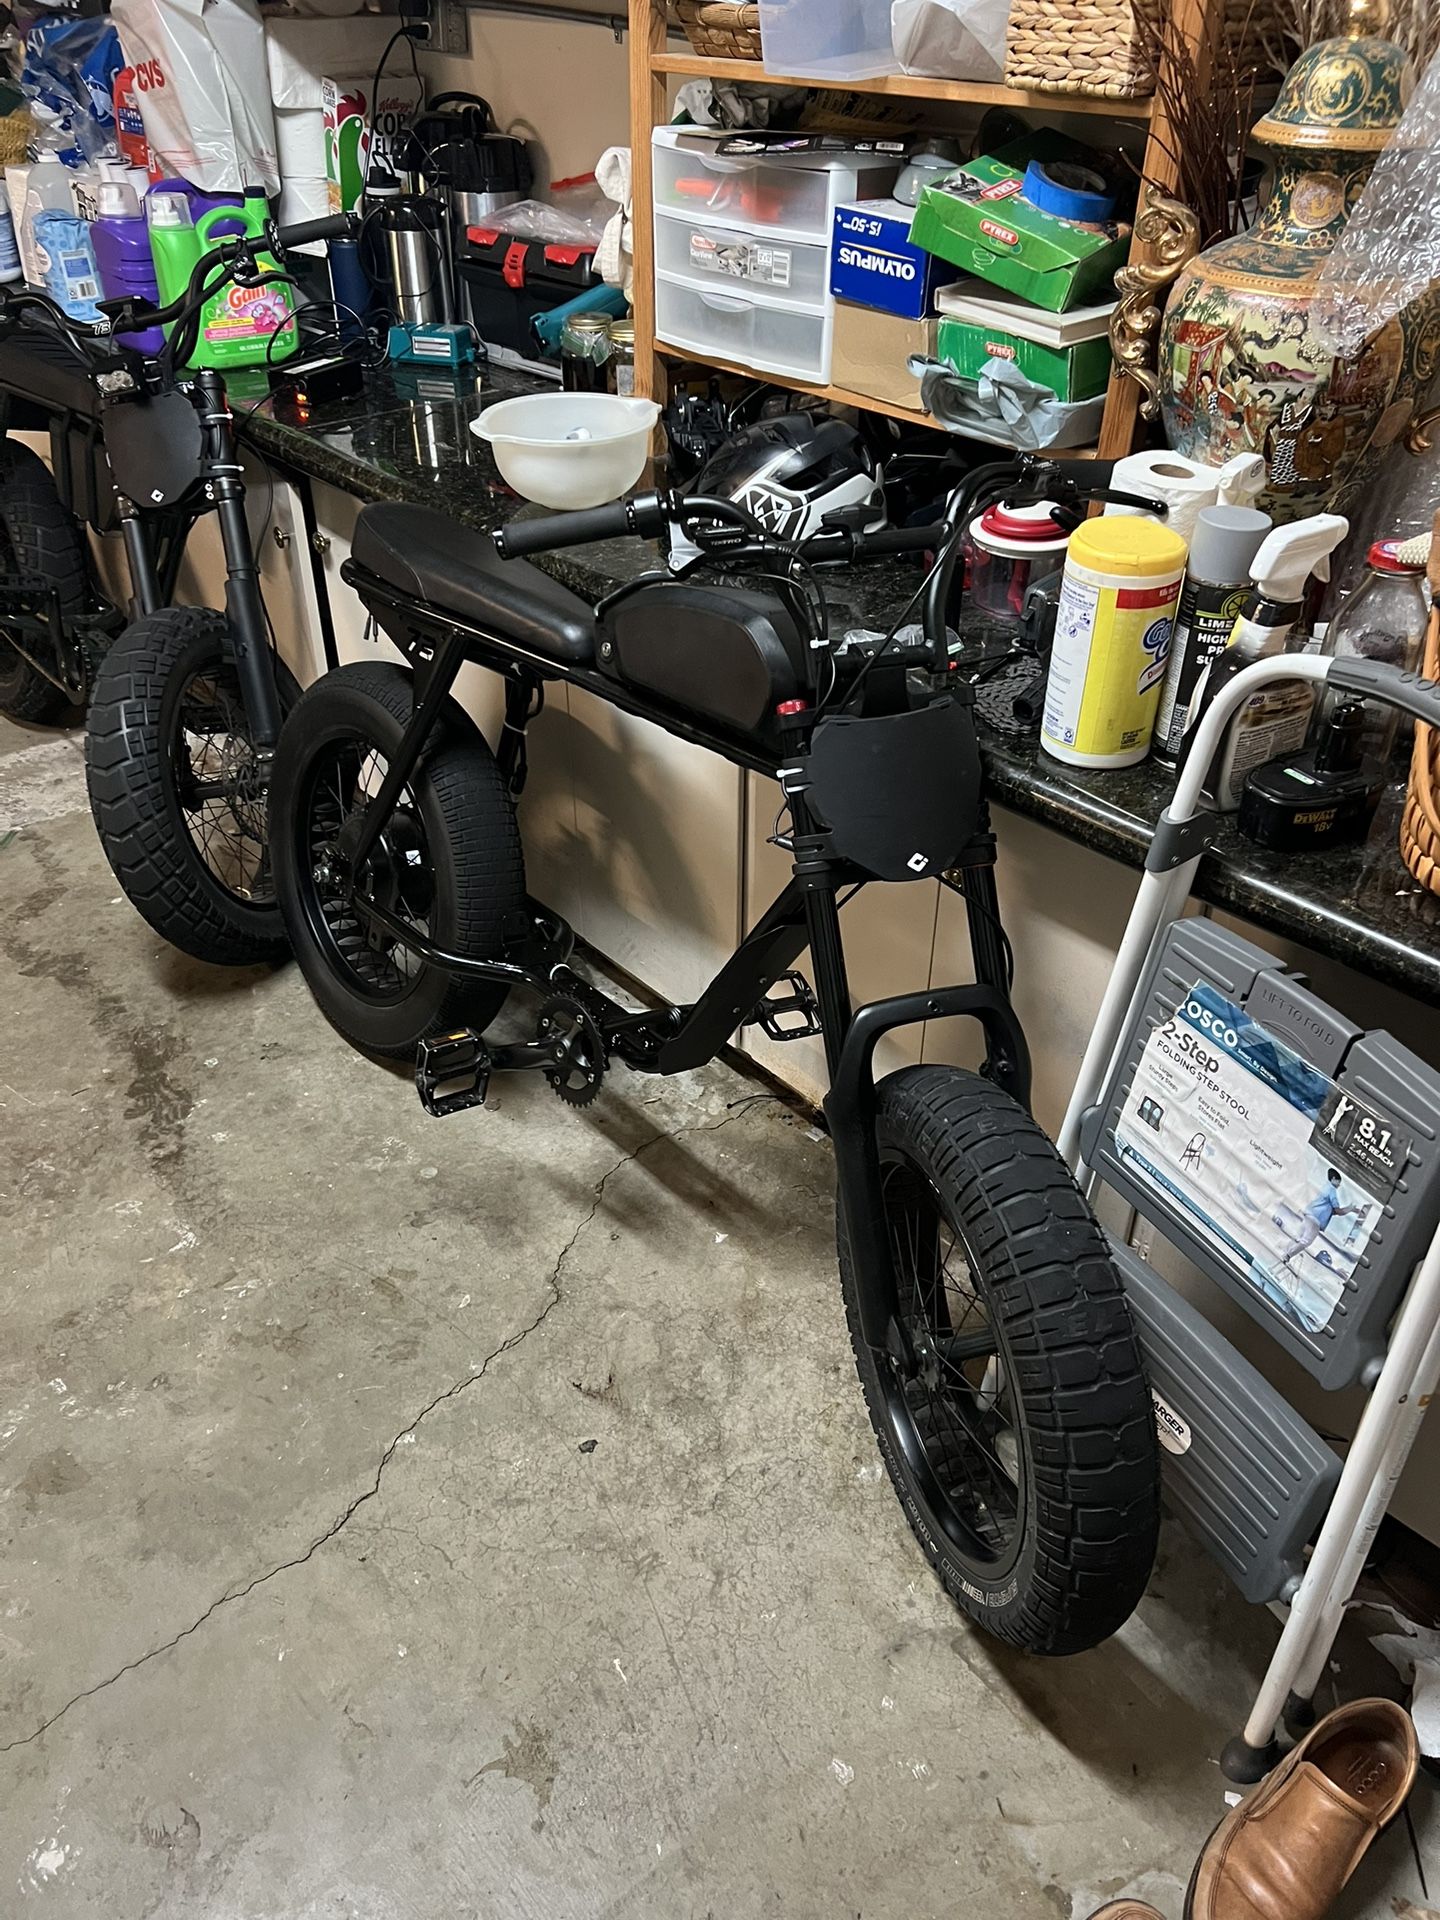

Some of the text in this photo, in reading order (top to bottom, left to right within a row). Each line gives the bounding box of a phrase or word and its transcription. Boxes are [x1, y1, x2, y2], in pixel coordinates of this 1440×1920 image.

[136, 59, 166, 92] CVS
[982, 221, 1015, 242] PYREX
[838, 247, 916, 281] OLYMPUS
[228, 286, 267, 311] Gain
[91, 320, 111, 335] 73
[986, 344, 1013, 358] PYREX
[1197, 632, 1229, 645] HIGH
[1177, 1000, 1238, 1048] OSCO
[1262, 988, 1335, 1046] LIFT TO FOLD
[1161, 1021, 1219, 1074] 2-Step
[1148, 1064, 1178, 1093] Sturdy Steps
[1156, 1039, 1250, 1121] FOLDING STEP STOOL
[1158, 1063, 1174, 1079] Large
[1198, 1096, 1210, 1110] Easy
[1209, 1105, 1217, 1114] to
[1198, 1104, 1225, 1130] Stores Flat
[1249, 1139, 1283, 1171] Lightweight
[1348, 1143, 1375, 1167] 2.46 m
[1353, 1132, 1370, 1149] MAX
[1368, 1145, 1395, 1168] REACH
[1152, 1401, 1185, 1436] ARGER
